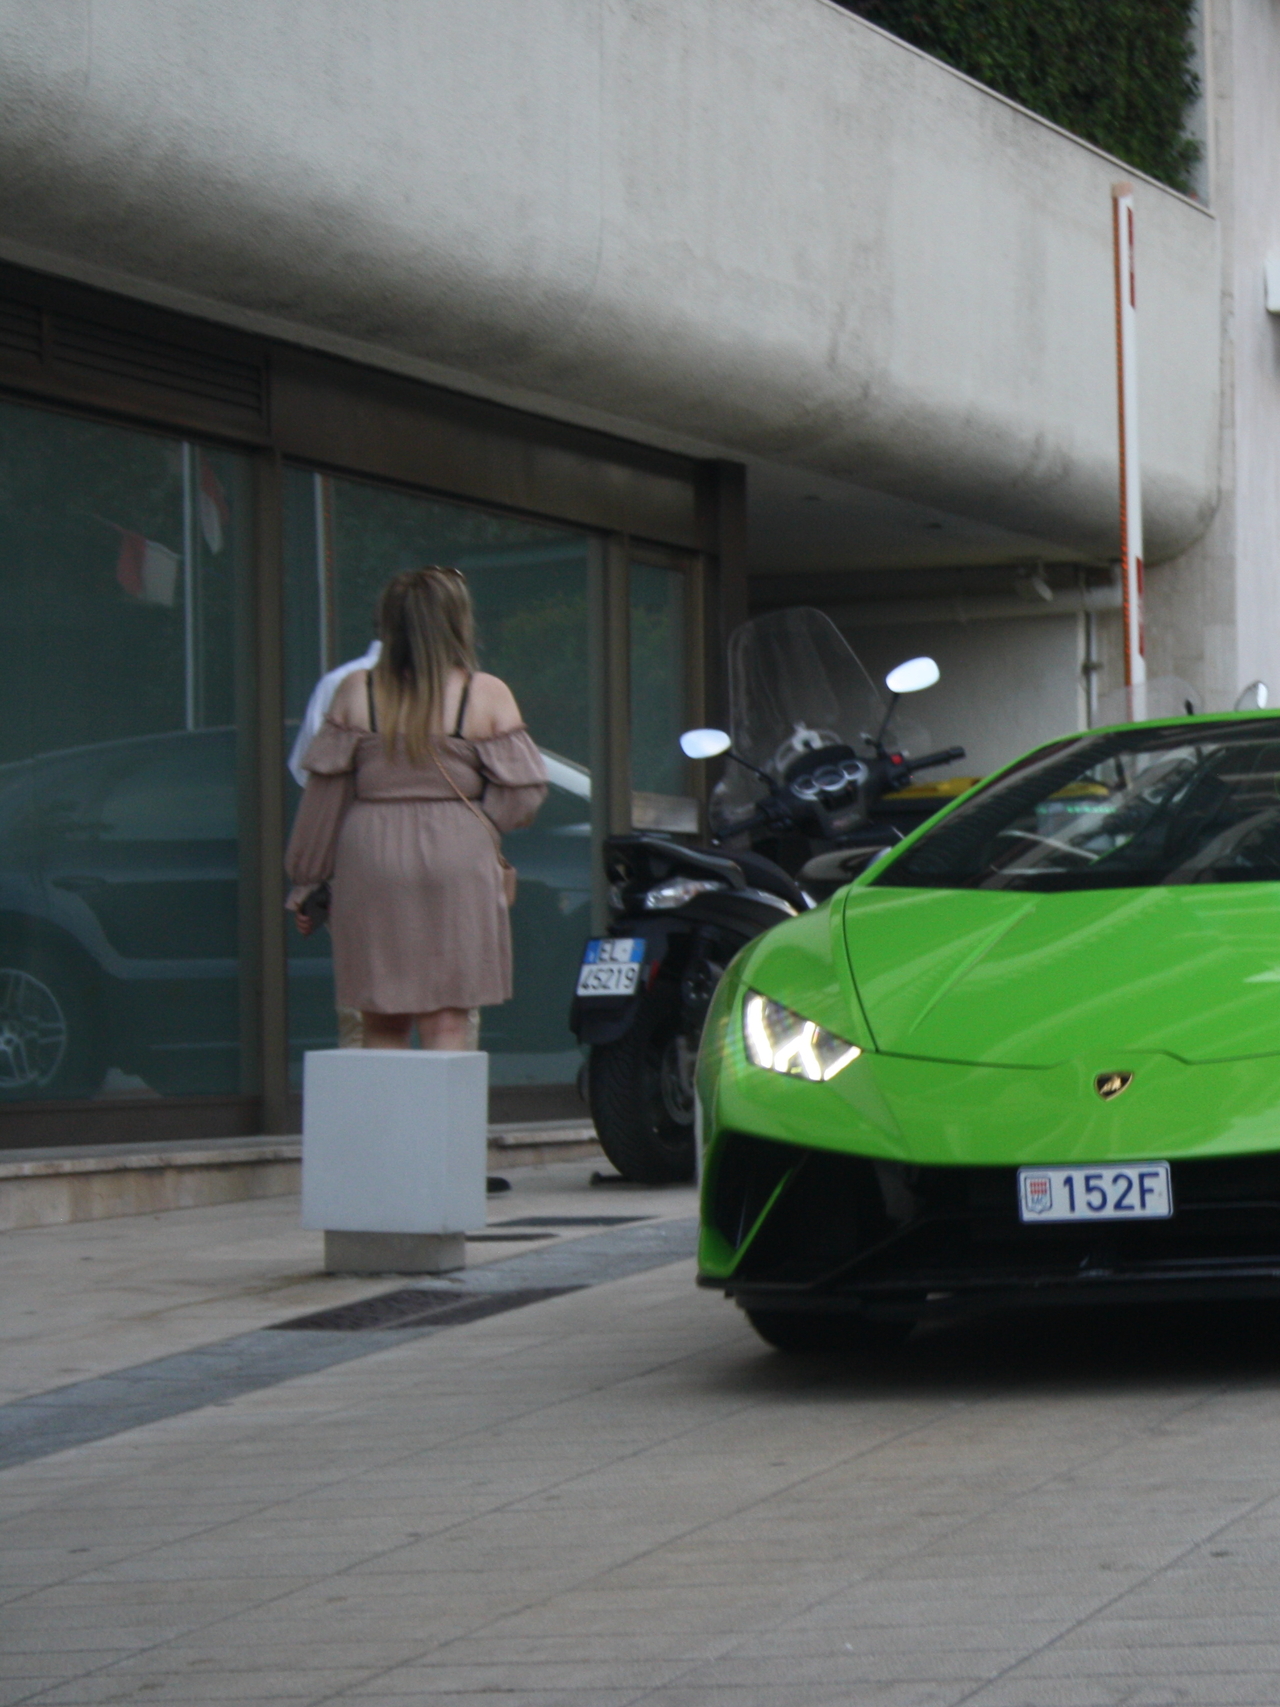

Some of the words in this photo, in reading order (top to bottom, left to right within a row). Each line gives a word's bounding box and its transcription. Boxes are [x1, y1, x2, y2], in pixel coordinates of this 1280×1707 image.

[598, 938, 619, 963] EL
[580, 967, 637, 990] 45219
[1063, 1172, 1160, 1213] 152F
